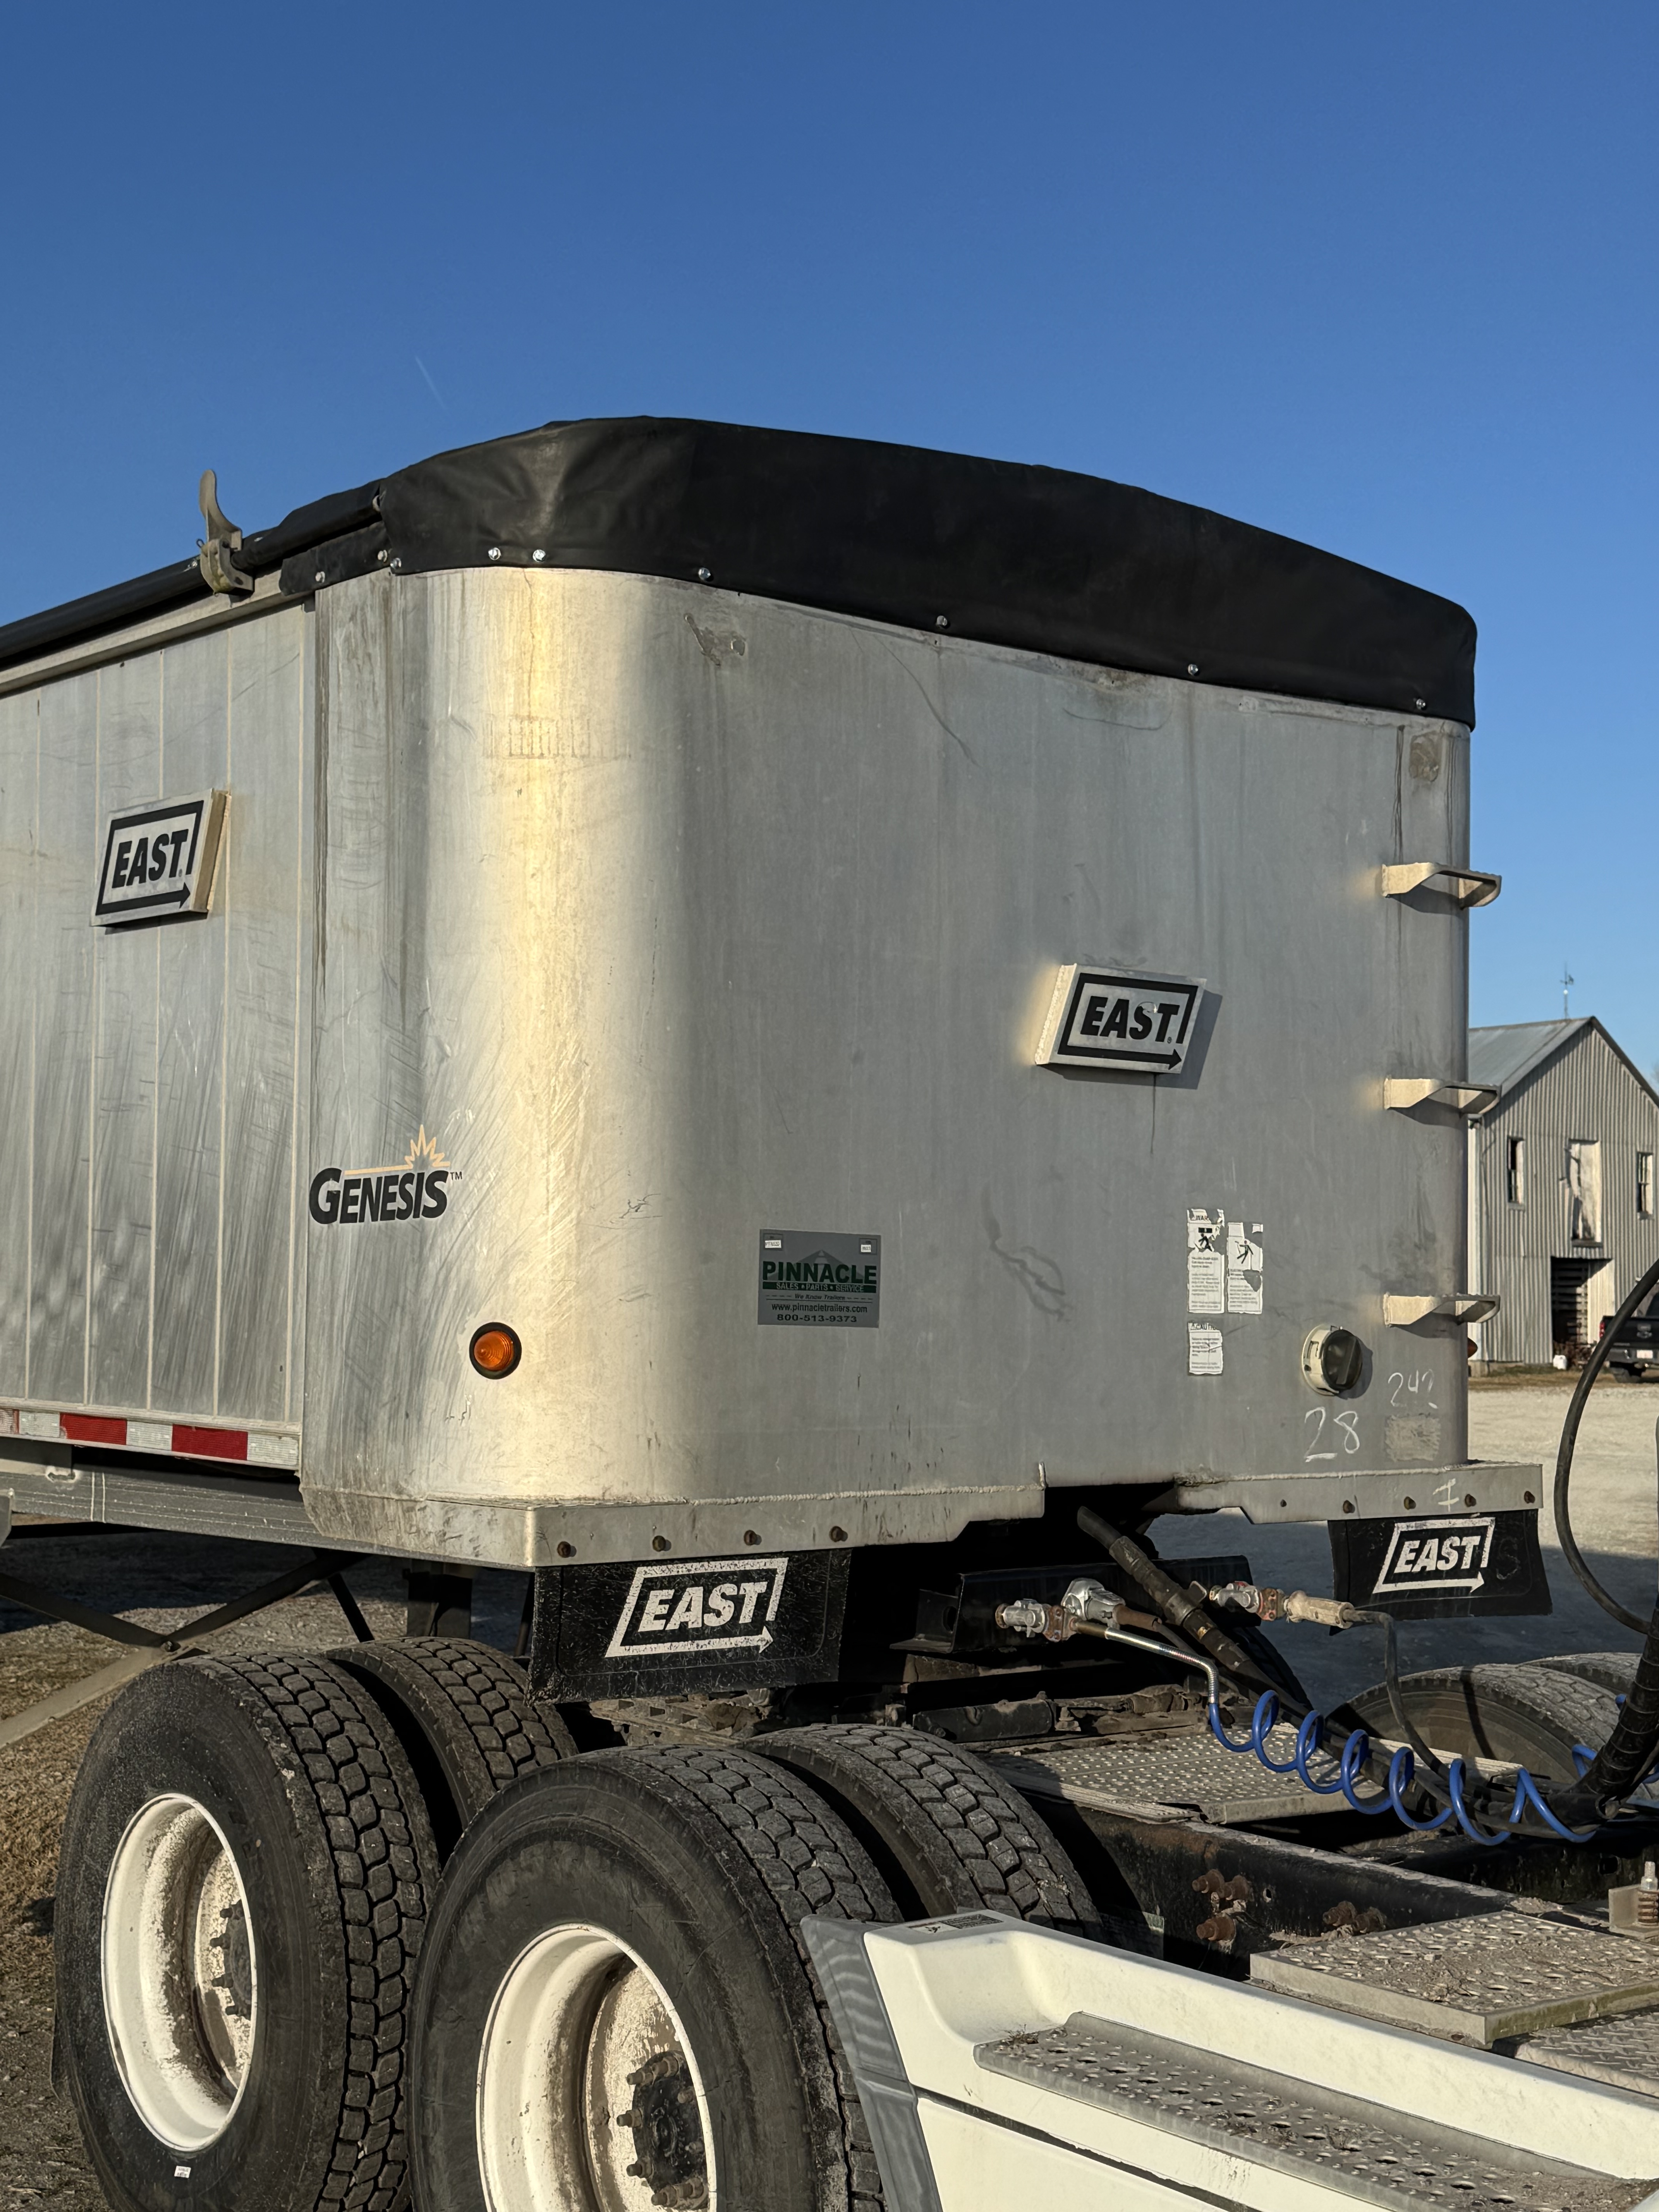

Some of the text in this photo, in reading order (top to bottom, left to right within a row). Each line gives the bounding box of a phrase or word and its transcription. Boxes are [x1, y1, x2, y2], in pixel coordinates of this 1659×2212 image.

[112, 829, 189, 889] EAST
[1080, 996, 1180, 1042] EAST
[310, 1167, 449, 1224] GENESIS
[763, 1261, 877, 1284] PINNACLE
[836, 1284, 864, 1293] SERVICE
[772, 1303, 867, 1313] www.pinnacletrailers.com
[777, 1314, 857, 1323] 800-513-9373
[1304, 1407, 1360, 1462] 28
[1394, 1535, 1481, 1573] EAST
[638, 1581, 768, 1633] EAST
